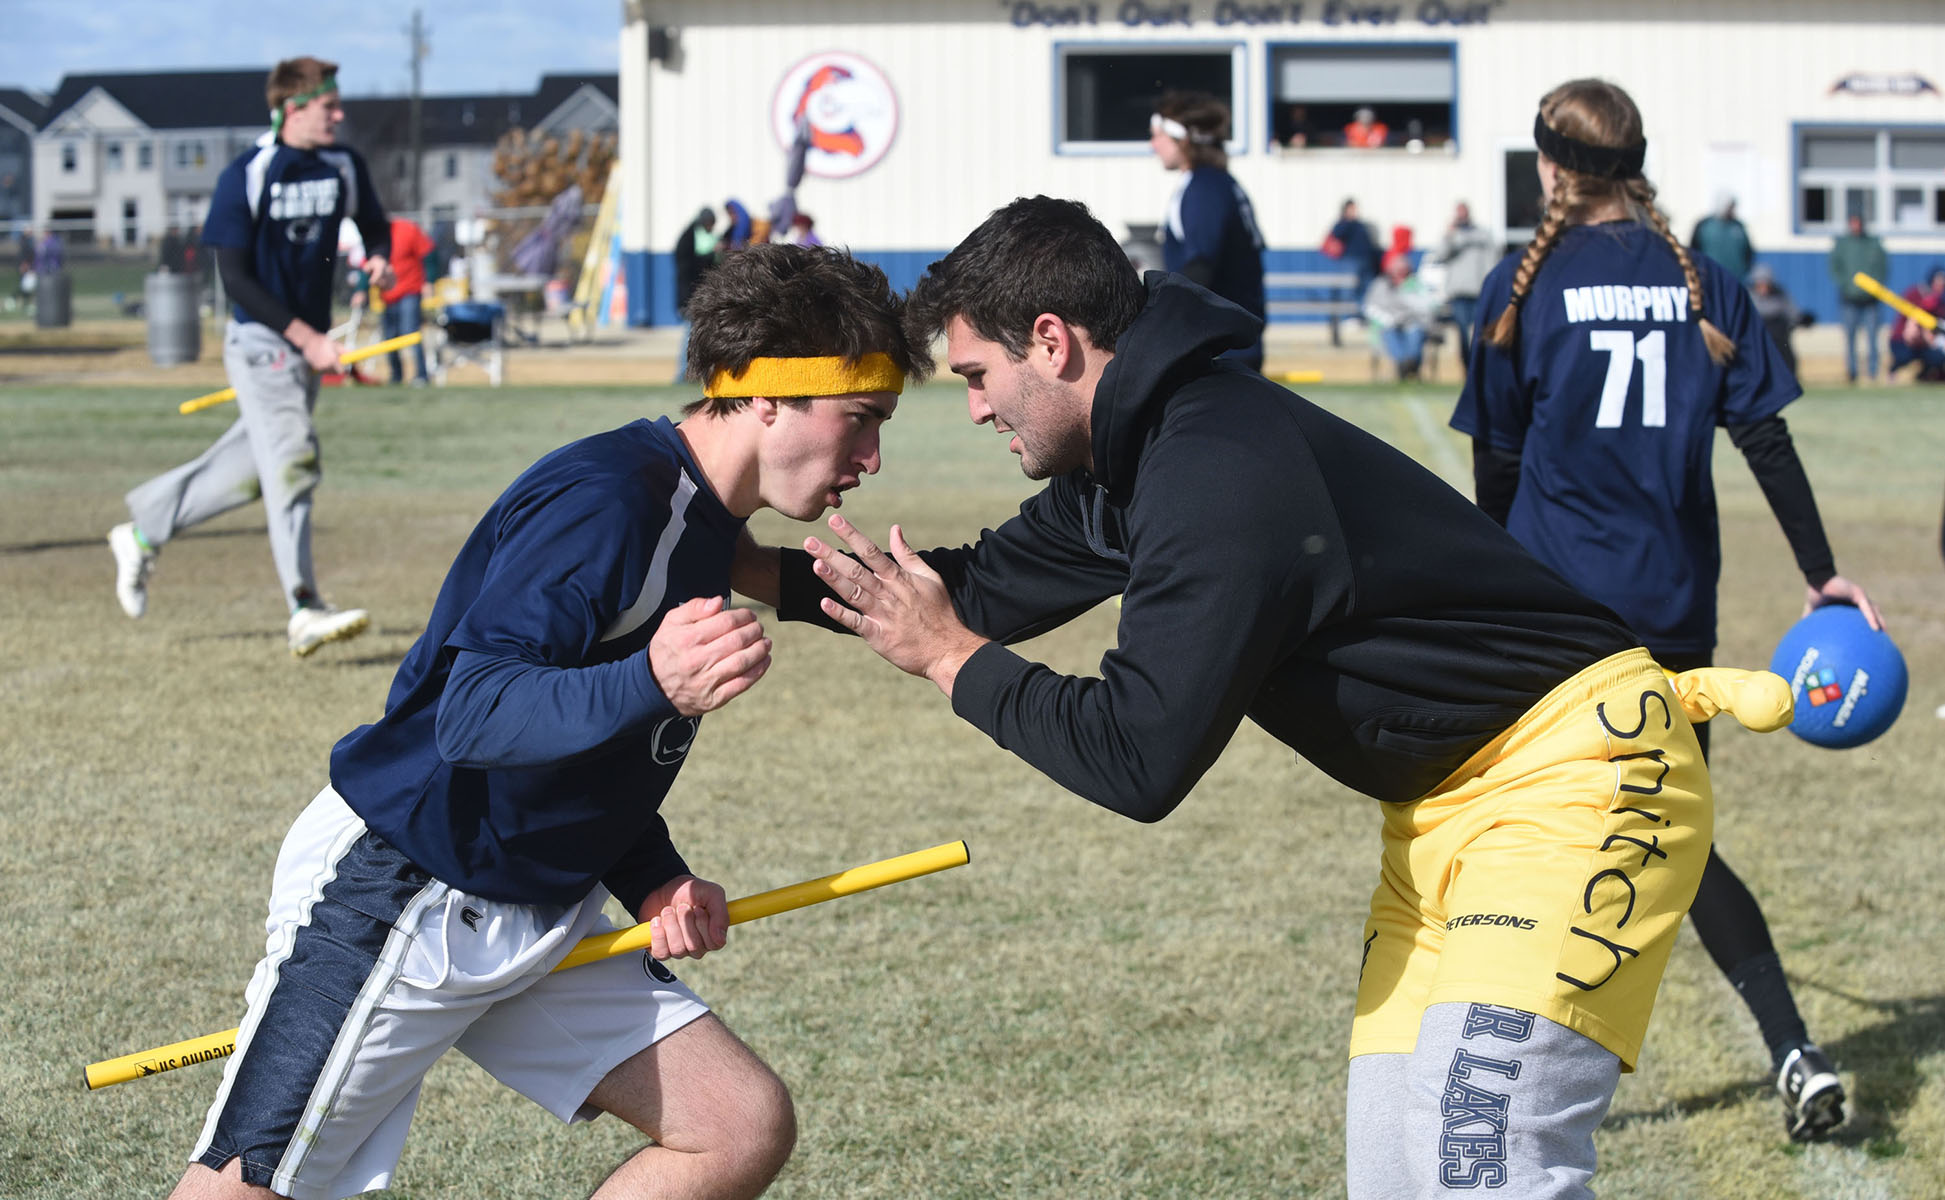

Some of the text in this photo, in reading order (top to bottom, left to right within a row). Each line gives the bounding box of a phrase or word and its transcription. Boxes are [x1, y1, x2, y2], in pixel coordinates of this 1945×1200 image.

[1563, 284, 1689, 324] MURPHY
[1589, 329, 1667, 429] 71
[1556, 690, 1672, 992] Snitch
[1439, 1002, 1539, 1189] R LAKES
